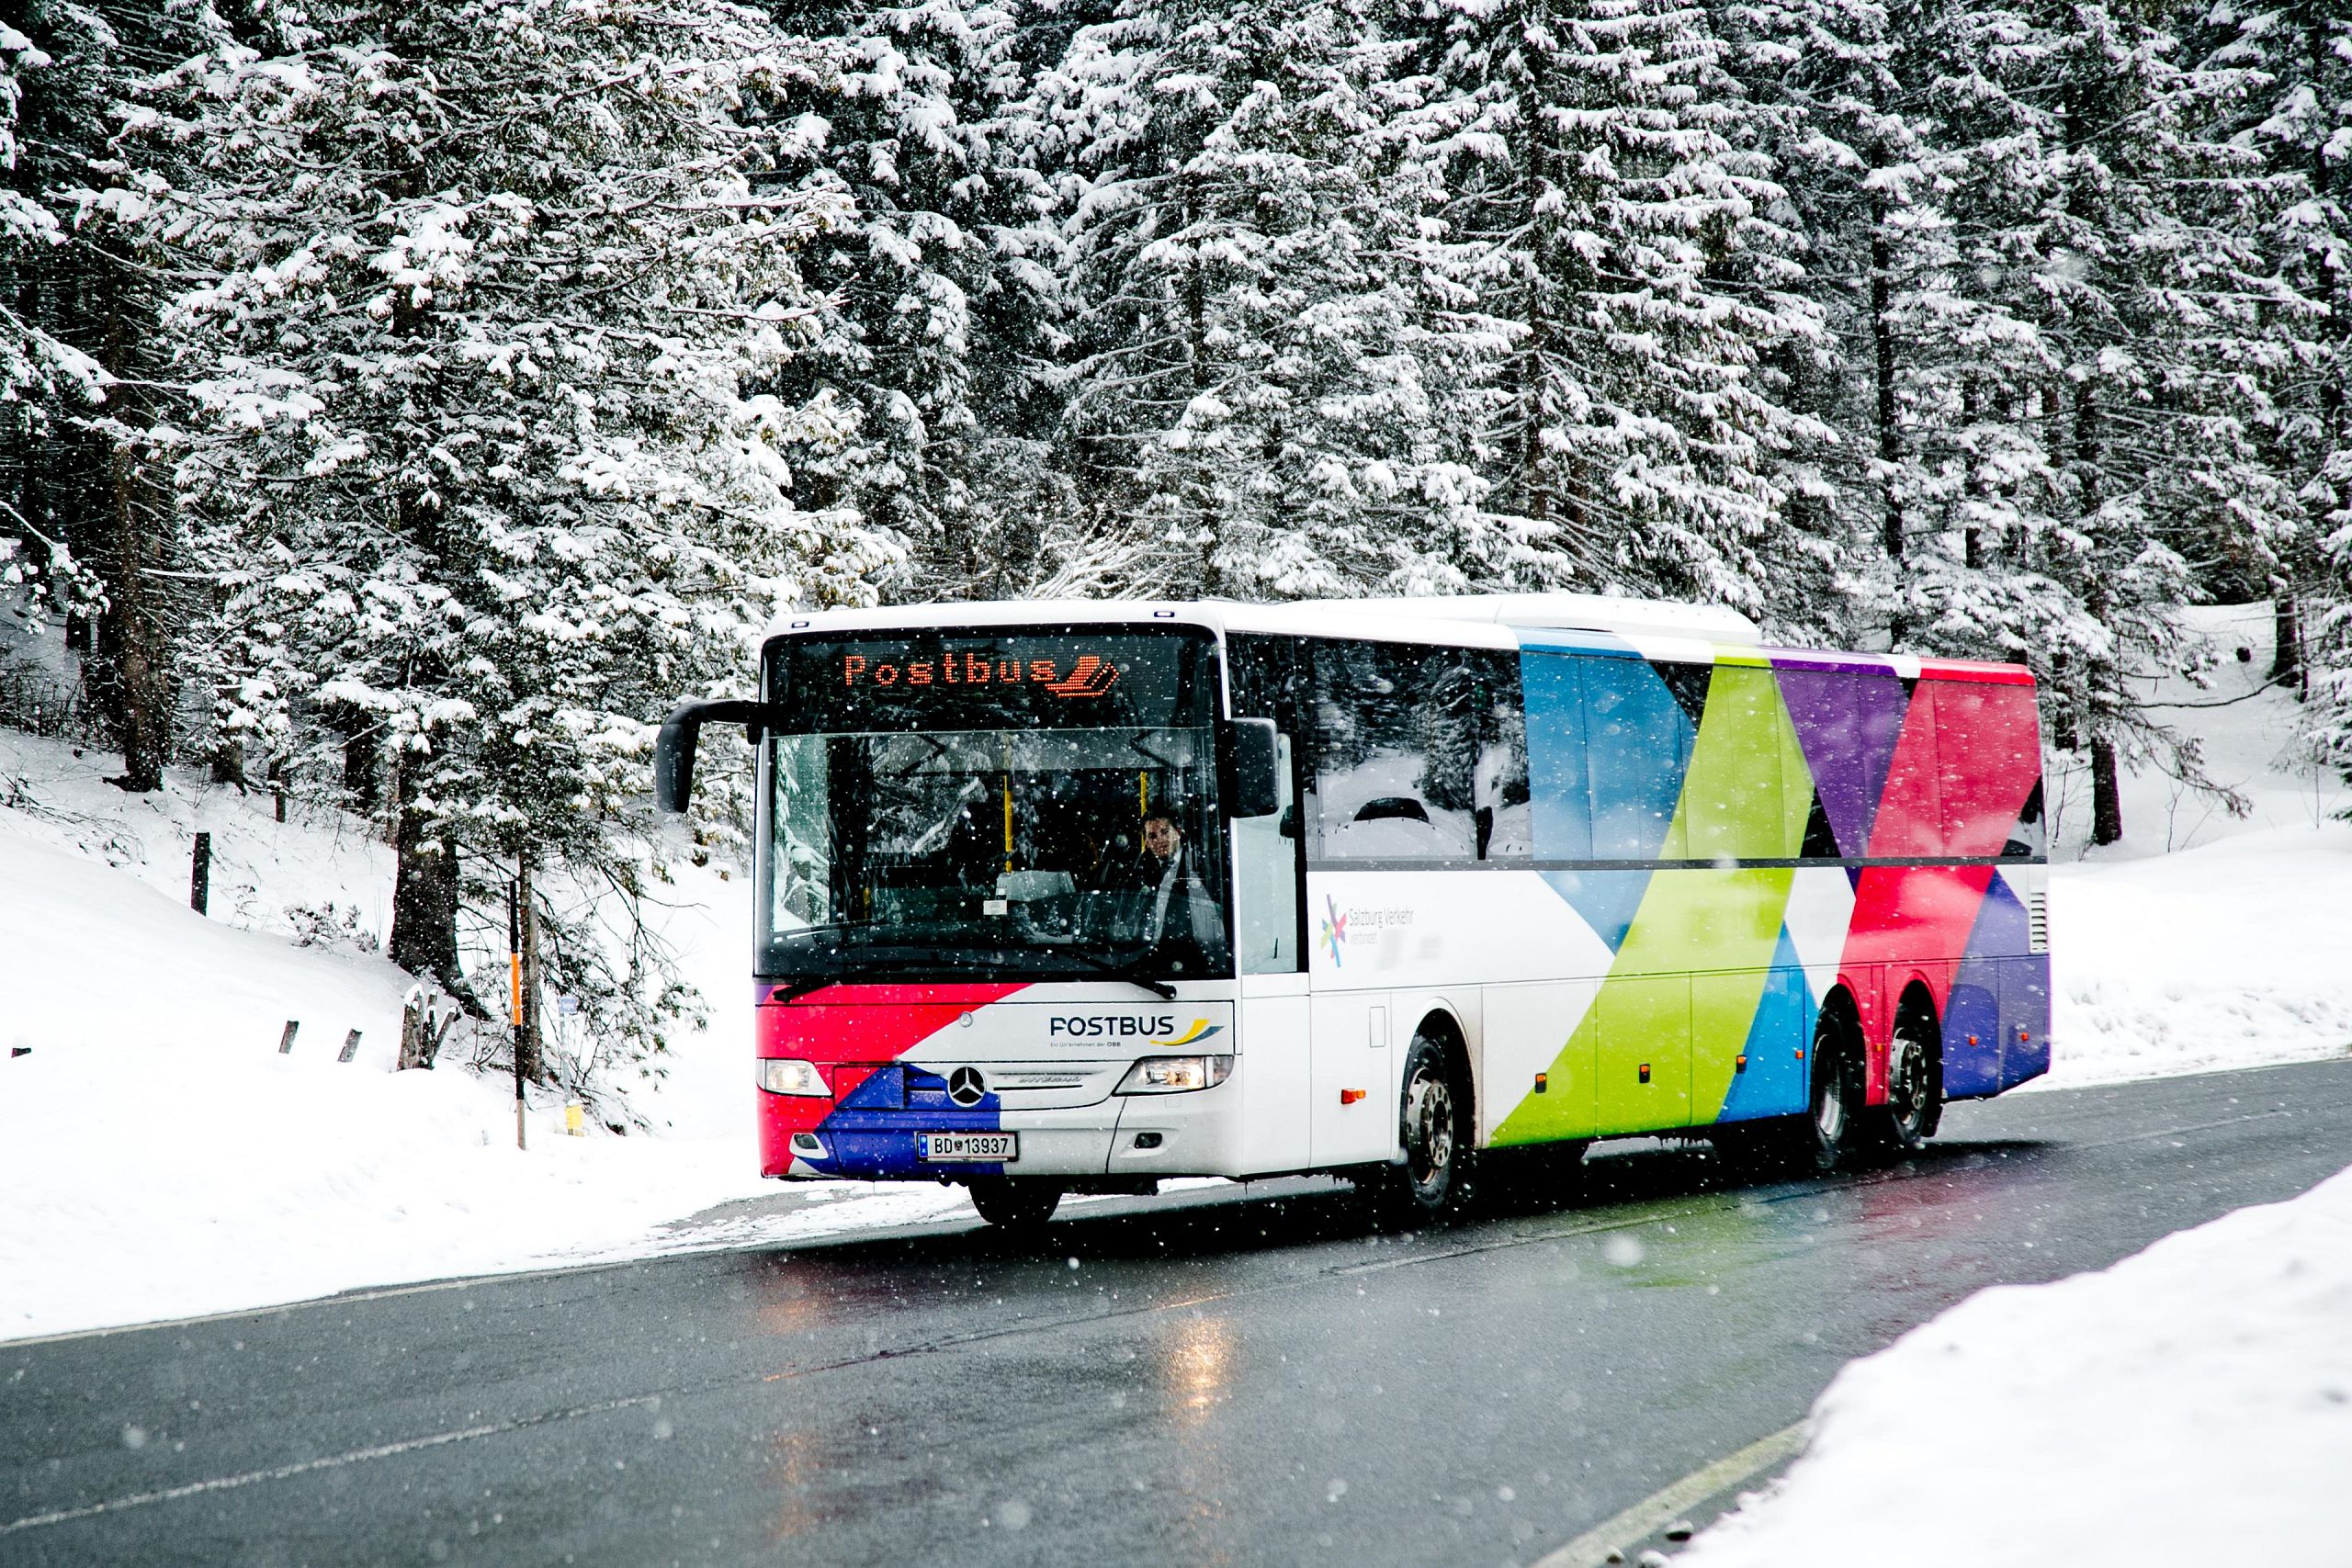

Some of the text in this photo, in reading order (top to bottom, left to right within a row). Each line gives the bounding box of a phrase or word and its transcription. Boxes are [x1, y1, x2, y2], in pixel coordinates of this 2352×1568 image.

[845, 652, 1056, 685] Postbus
[1349, 906, 1414, 929] Salzburg Verkehr
[1050, 1016, 1174, 1036] POSTBUS
[934, 1138, 1009, 1154] BD 13937
